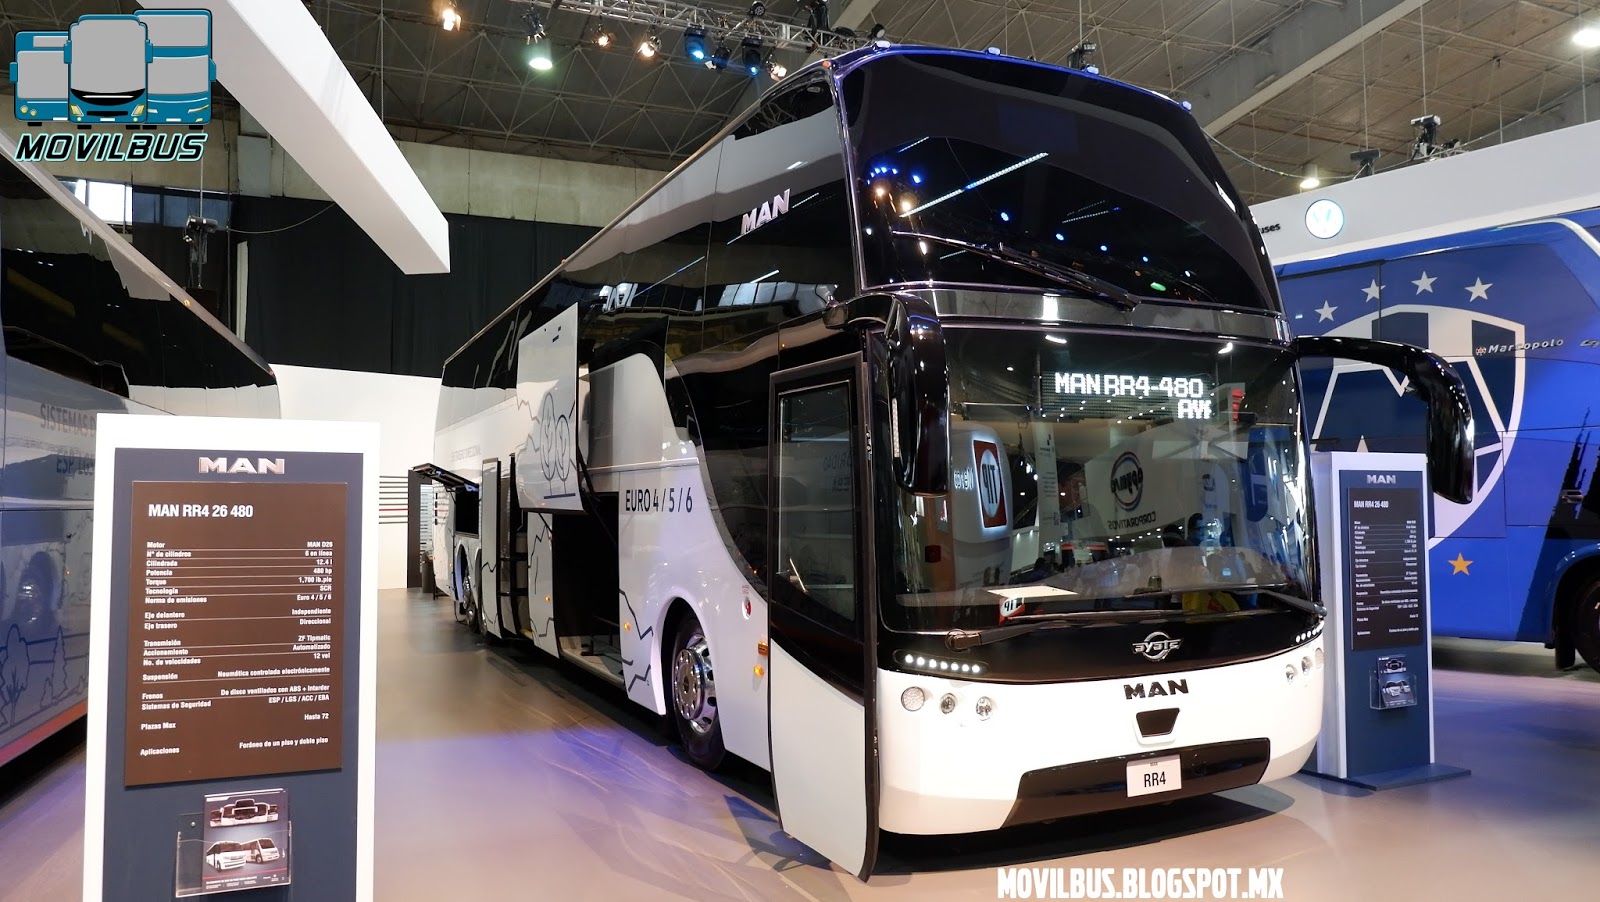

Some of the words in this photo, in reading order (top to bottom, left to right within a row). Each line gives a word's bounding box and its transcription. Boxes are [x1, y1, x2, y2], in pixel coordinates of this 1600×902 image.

[740, 188, 791, 236] MAN
[1260, 223, 1281, 235] uses
[1488, 338, 1564, 354] Marcopolo
[1054, 371, 1101, 395] MAN
[1103, 373, 1204, 398] RR4-480
[40, 402, 90, 437] SISTEMAS
[198, 457, 285, 475] MAN
[1366, 474, 1397, 484] MAN
[625, 488, 651, 512] EURO
[653, 488, 659, 512] 4
[661, 488, 667, 512] /
[668, 488, 675, 513] 5
[677, 487, 683, 512] /
[685, 487, 693, 513] 6
[148, 503, 180, 517] MAN
[182, 504, 210, 517] RR4
[212, 505, 228, 518] 26
[230, 505, 254, 518] 480
[146, 541, 166, 549] Motor
[165, 550, 192, 558] cilindros
[146, 578, 167, 586] Torque
[144, 612, 155, 620] Eje
[307, 634, 331, 642] Tipmatic
[250, 668, 281, 676] controlada
[1123, 678, 1189, 700] MAN
[180, 700, 212, 709] Seguridad
[269, 696, 281, 704] ESP
[285, 695, 297, 703] LGS
[281, 739, 294, 747] piso
[140, 747, 180, 756] Aplicaciones
[1143, 771, 1166, 788] RR4
